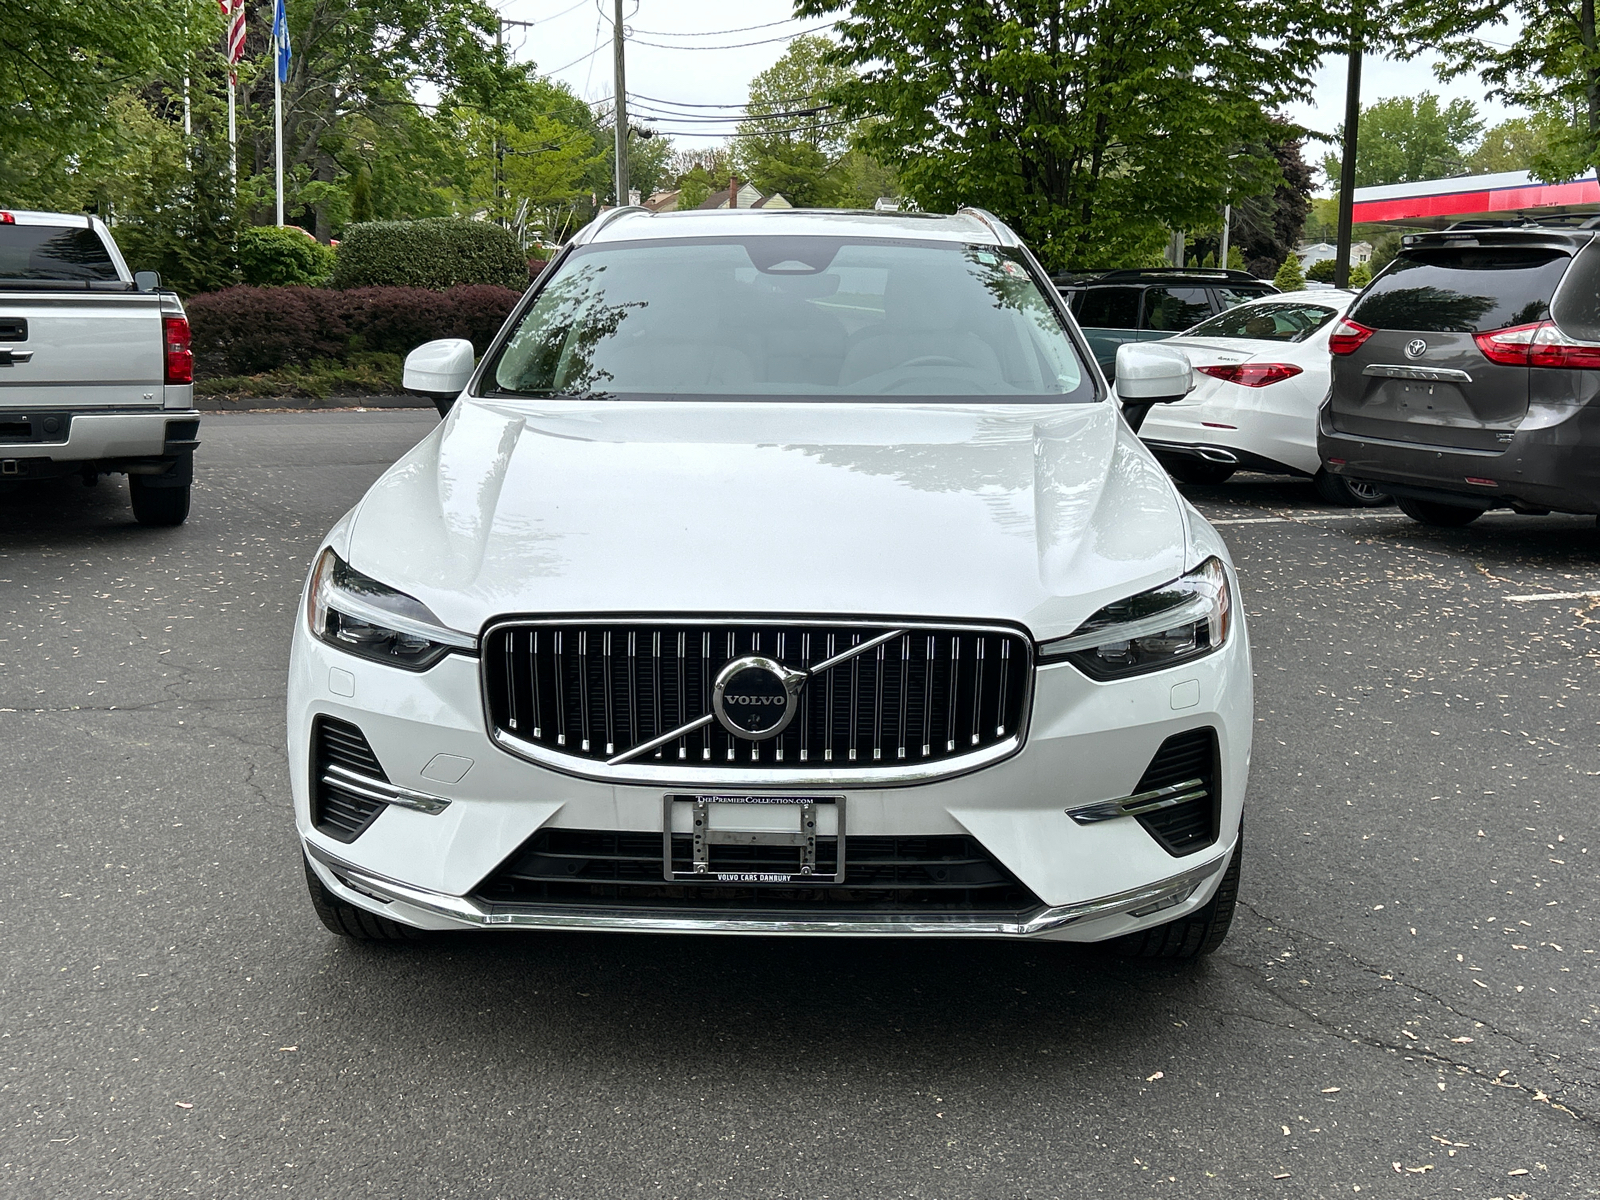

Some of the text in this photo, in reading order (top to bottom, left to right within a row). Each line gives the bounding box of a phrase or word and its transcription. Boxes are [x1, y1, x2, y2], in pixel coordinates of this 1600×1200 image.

[724, 695, 785, 705] VOLVO
[717, 873, 739, 881] VOLVO
[759, 874, 791, 882] DANBURY
